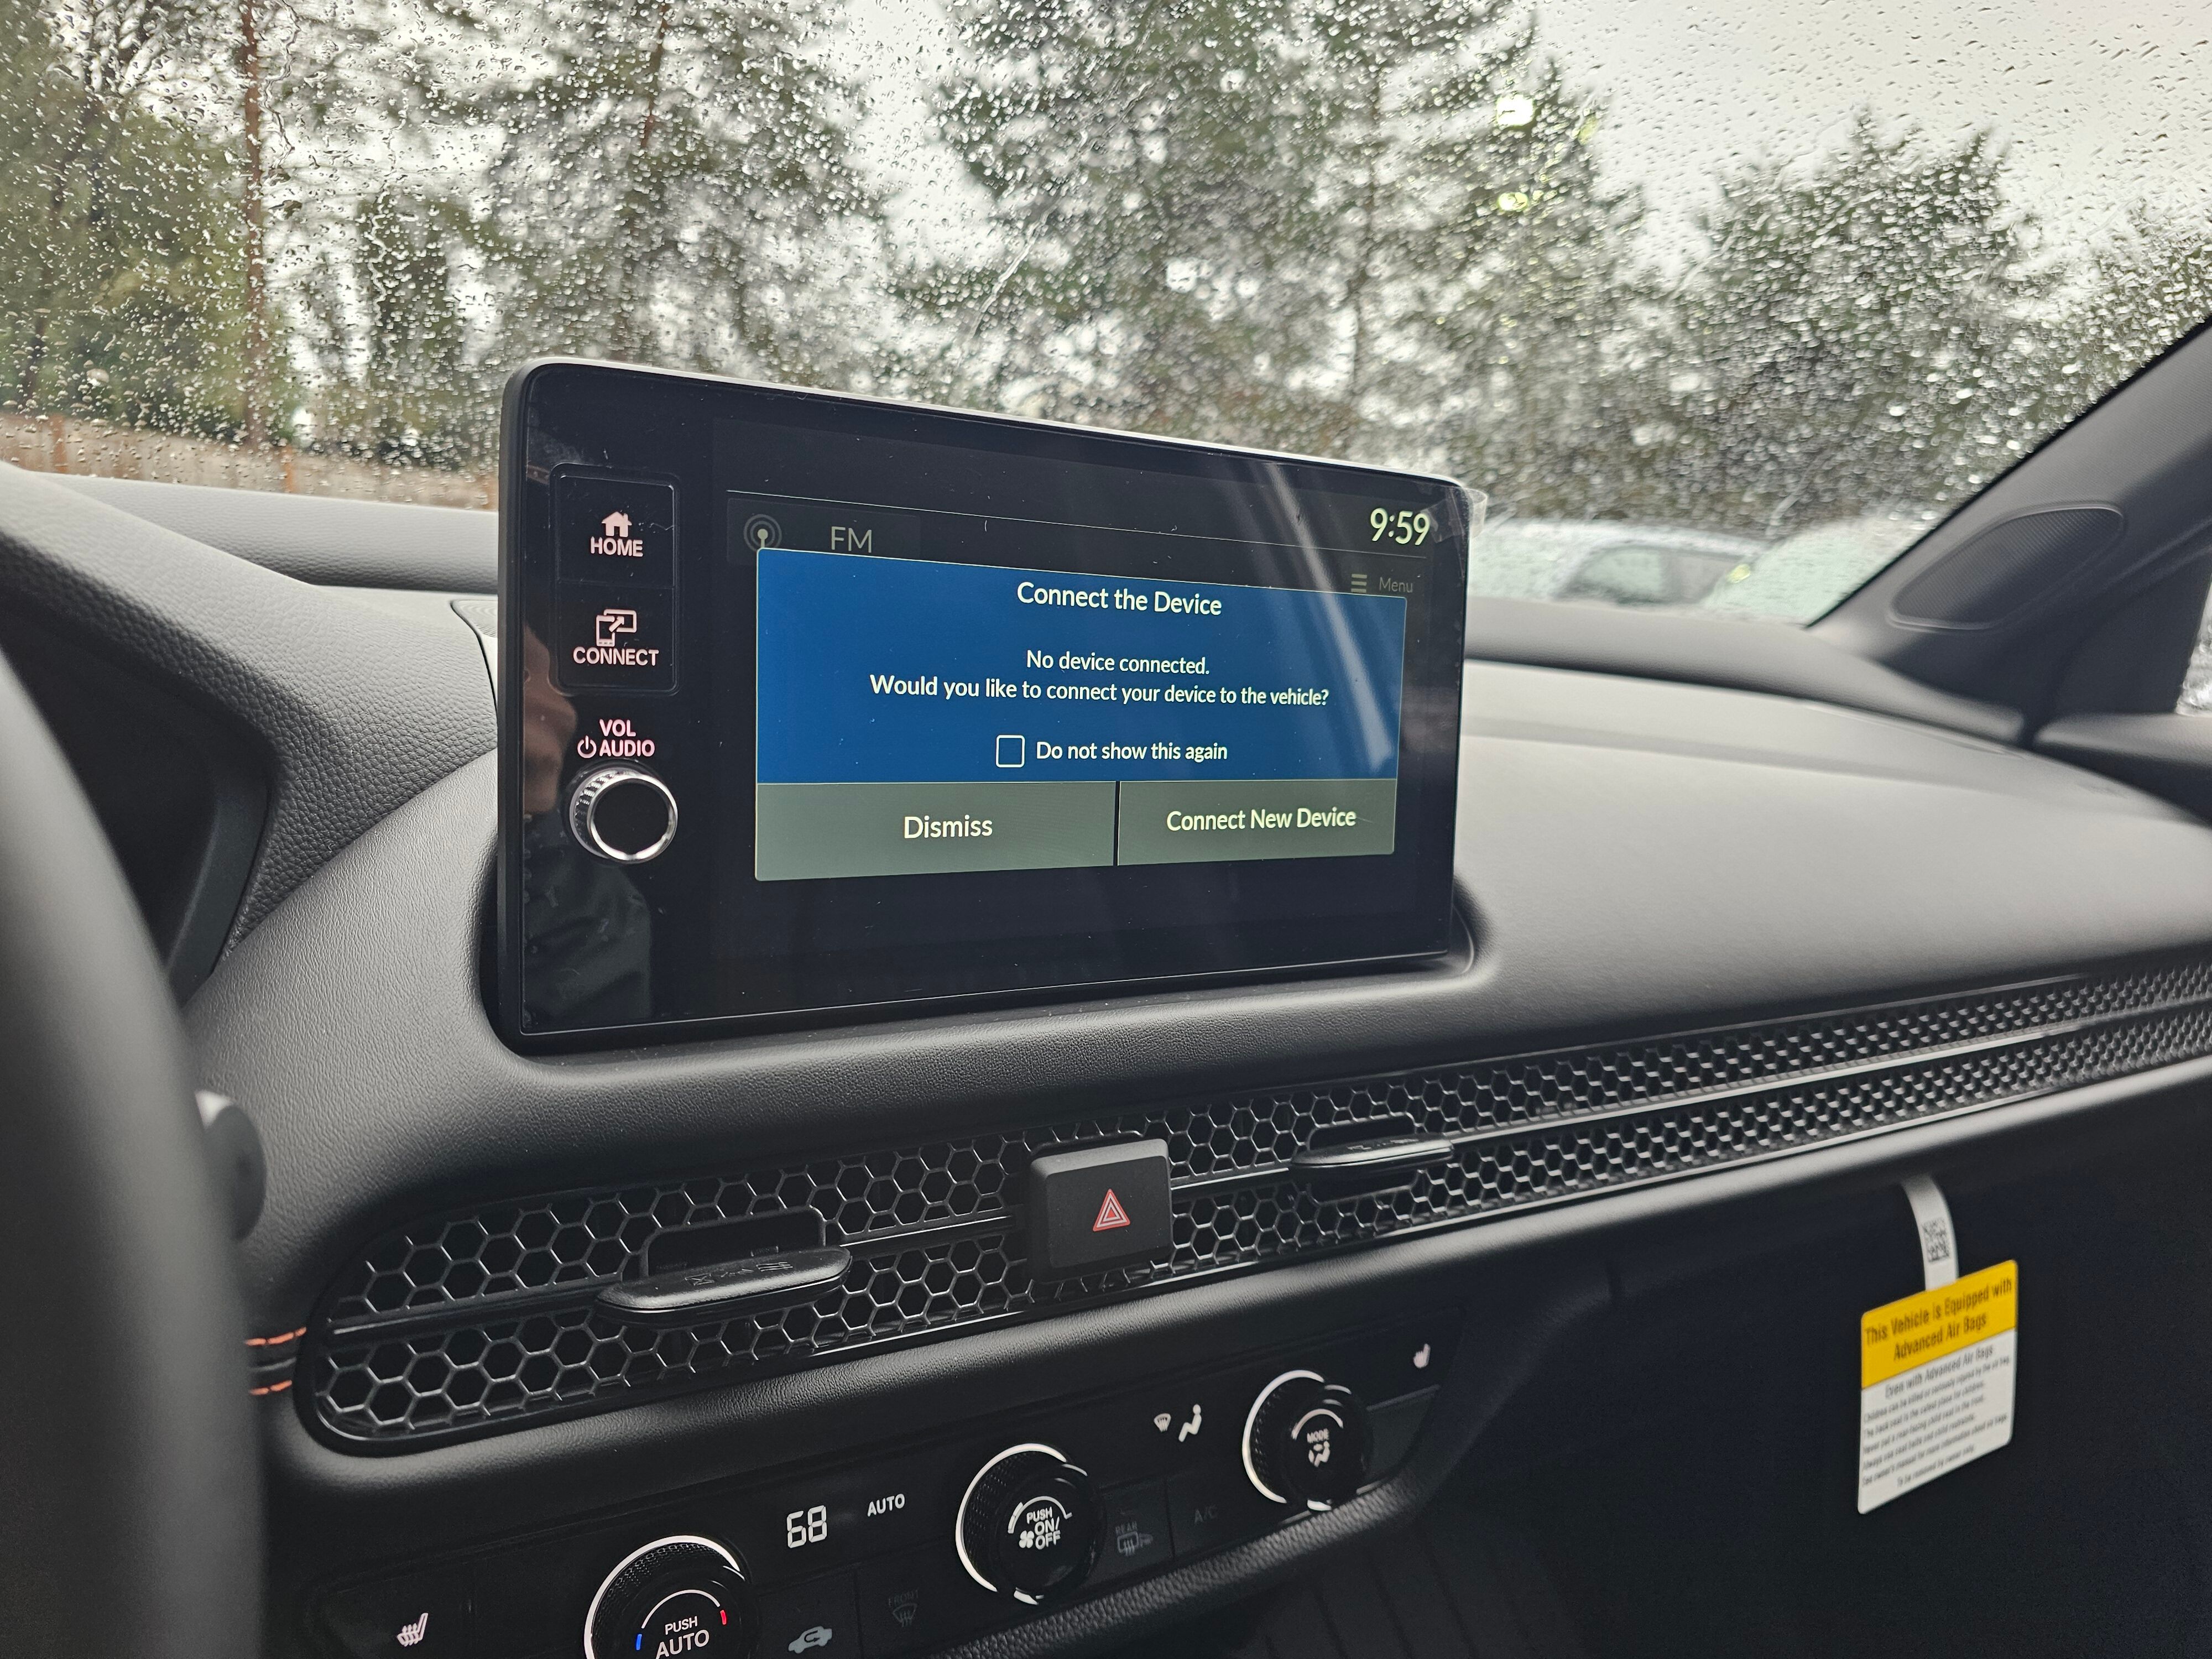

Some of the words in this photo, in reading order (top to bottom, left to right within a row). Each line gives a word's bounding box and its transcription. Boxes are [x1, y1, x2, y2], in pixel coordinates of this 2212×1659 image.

[1370, 508, 1431, 545] 9:59
[591, 536, 643, 557] HOME
[830, 526, 873, 553] FM
[1379, 577, 1413, 593] Menu
[1017, 582, 1109, 609] Connect
[1114, 588, 1148, 611] the
[1154, 591, 1222, 615] Device
[573, 645, 659, 666] CONNECT
[1027, 650, 1054, 669] No
[1059, 651, 1115, 671] device
[1119, 656, 1209, 675] connected.
[869, 674, 938, 696] Would
[943, 682, 979, 700] you
[985, 678, 1017, 698] like
[1021, 681, 1042, 698] to
[1046, 684, 1118, 701] connect
[1121, 687, 1161, 705] your
[1164, 684, 1216, 703] device
[1219, 687, 1237, 703] to
[1240, 686, 1267, 704] the
[1270, 687, 1329, 706] vehicle?
[599, 719, 637, 737] VOL
[599, 739, 655, 757] AUDIO
[1036, 741, 1063, 759] Do
[1068, 743, 1098, 759] not
[1101, 742, 1147, 759] show
[1150, 742, 1181, 760] this
[1185, 742, 1228, 763] again
[904, 814, 993, 839] Dismiss
[1167, 810, 1246, 831] Connect
[1250, 808, 1293, 829] New
[1297, 806, 1357, 828] Device
[1865, 1325, 1887, 1344] This
[1890, 1310, 1929, 1335] Vehicle
[1932, 1305, 1941, 1320] is
[1944, 1286, 1989, 1316] Equipped
[1992, 1278, 2012, 1297] with
[1894, 1327, 1943, 1360] Advanced
[1946, 1323, 1959, 1339] Air
[1963, 1313, 1987, 1333] Bags
[1906, 1373, 1922, 1389] with
[1925, 1357, 1960, 1381] Advanced
[1963, 1353, 1973, 1366] Air
[867, 1494, 905, 1517] AUTO
[1026, 1506, 1053, 1525] PUSH
[786, 1505, 827, 1548] 68
[1034, 1516, 1060, 1536] ON/
[1035, 1530, 1061, 1550] OFF
[665, 1616, 698, 1635] PUSH
[655, 1629, 709, 1659] AUTO
